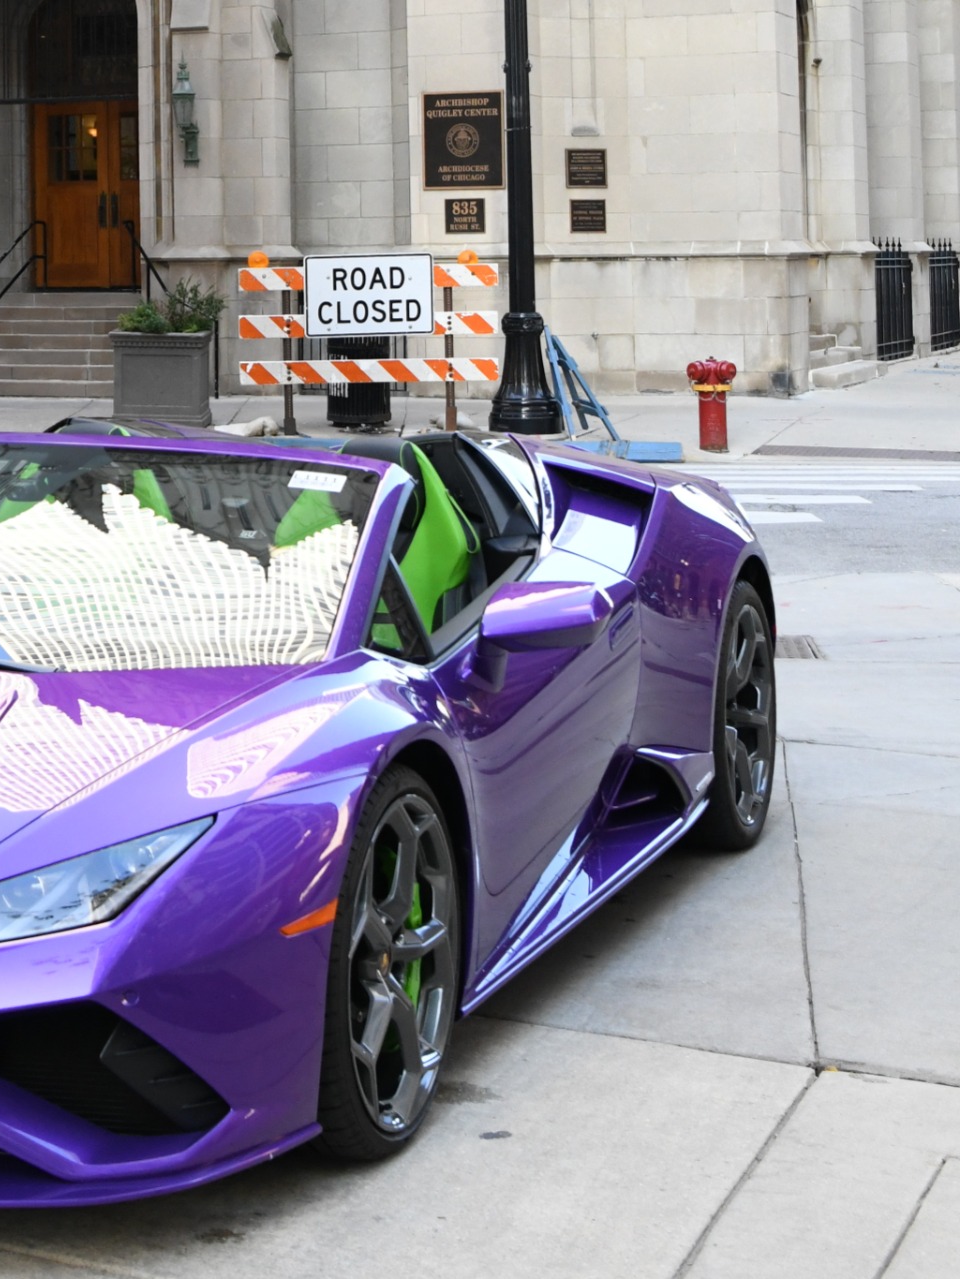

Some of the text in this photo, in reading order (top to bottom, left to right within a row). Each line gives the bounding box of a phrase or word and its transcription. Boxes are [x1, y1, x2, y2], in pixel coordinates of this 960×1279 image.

[435, 98, 489, 107] ARCHBISHOP
[426, 108, 498, 119] QUIGLEY CENTER
[438, 165, 489, 173] ARCHDIOCESE
[452, 201, 478, 215] 835
[332, 266, 405, 291] ROAD
[317, 299, 422, 324] CLOSED
